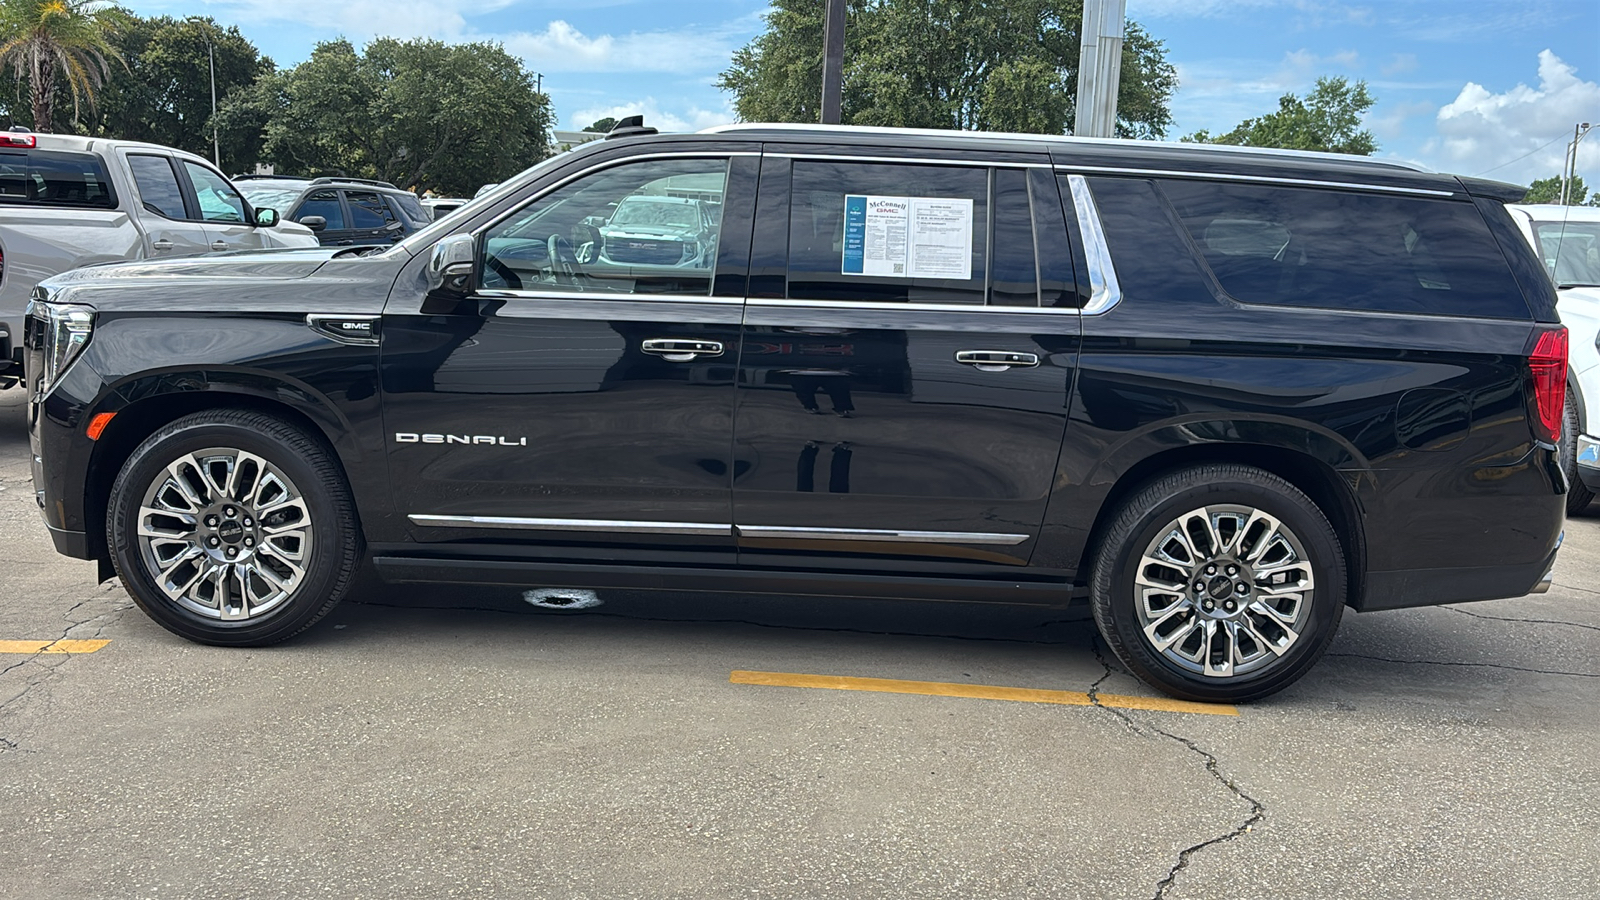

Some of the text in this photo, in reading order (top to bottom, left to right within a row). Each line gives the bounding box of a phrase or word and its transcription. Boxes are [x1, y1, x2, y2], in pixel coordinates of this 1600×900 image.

[869, 201, 907, 210] McConnell
[342, 322, 370, 330] GMC
[395, 432, 527, 446] DENALI
